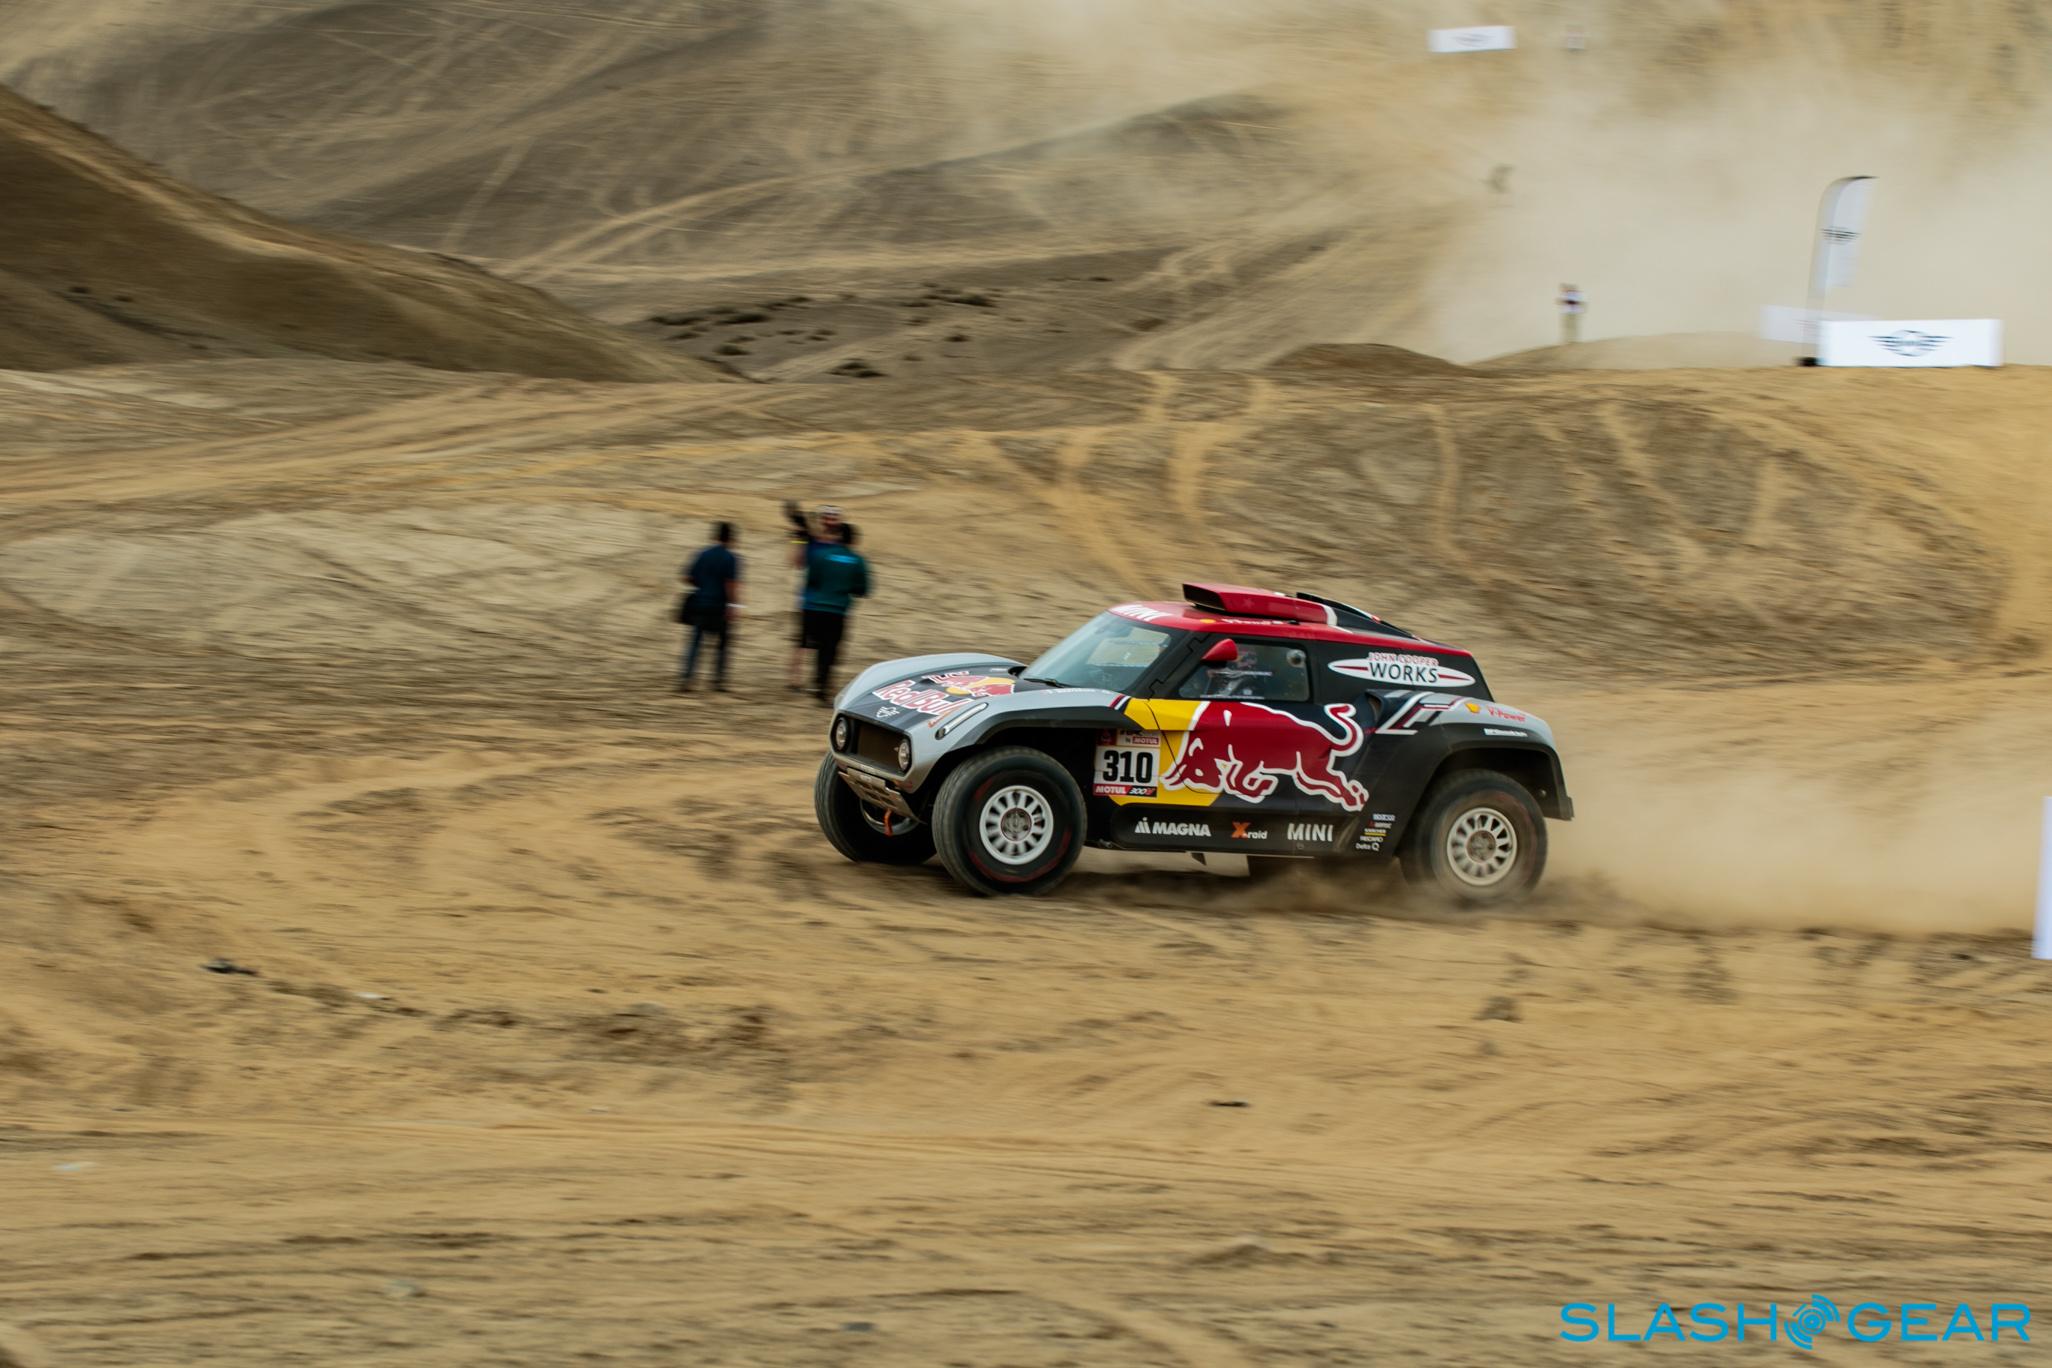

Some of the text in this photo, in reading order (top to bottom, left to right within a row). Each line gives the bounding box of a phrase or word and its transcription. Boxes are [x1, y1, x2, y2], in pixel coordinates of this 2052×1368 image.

[1369, 661, 1438, 684] WORKS
[1102, 750, 1154, 784] 310
[1095, 785, 1128, 795] MOTUL
[1152, 821, 1212, 838] MAGNA
[1287, 822, 1334, 843] MINI
